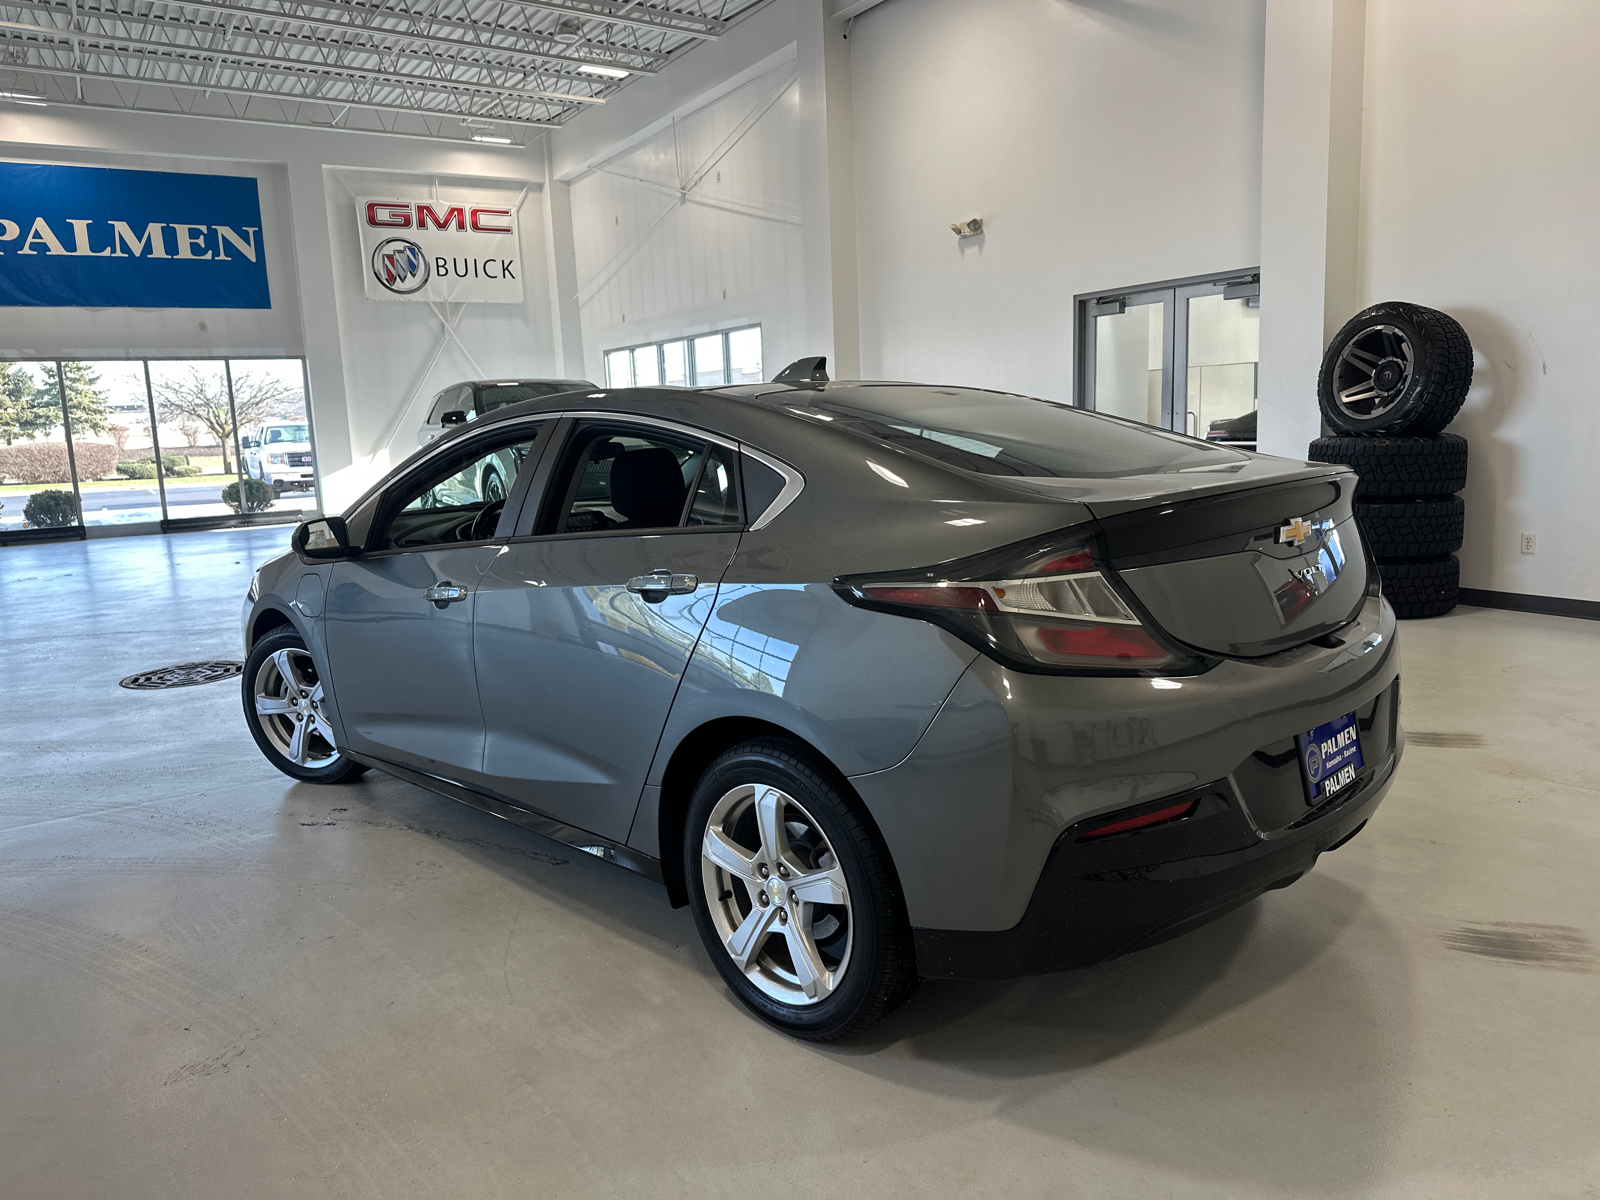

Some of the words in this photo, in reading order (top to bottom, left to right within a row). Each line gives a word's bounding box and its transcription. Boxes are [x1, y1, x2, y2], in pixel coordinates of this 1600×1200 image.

[365, 200, 513, 234] GMC
[435, 257, 516, 279] BUICK
[1292, 564, 1322, 579] VOLT
[1321, 724, 1357, 760] PALMEN
[1309, 755, 1319, 775] P
[1326, 754, 1342, 769] Kenosha
[1344, 746, 1357, 758] Racine
[1324, 763, 1356, 797] PALMEN
